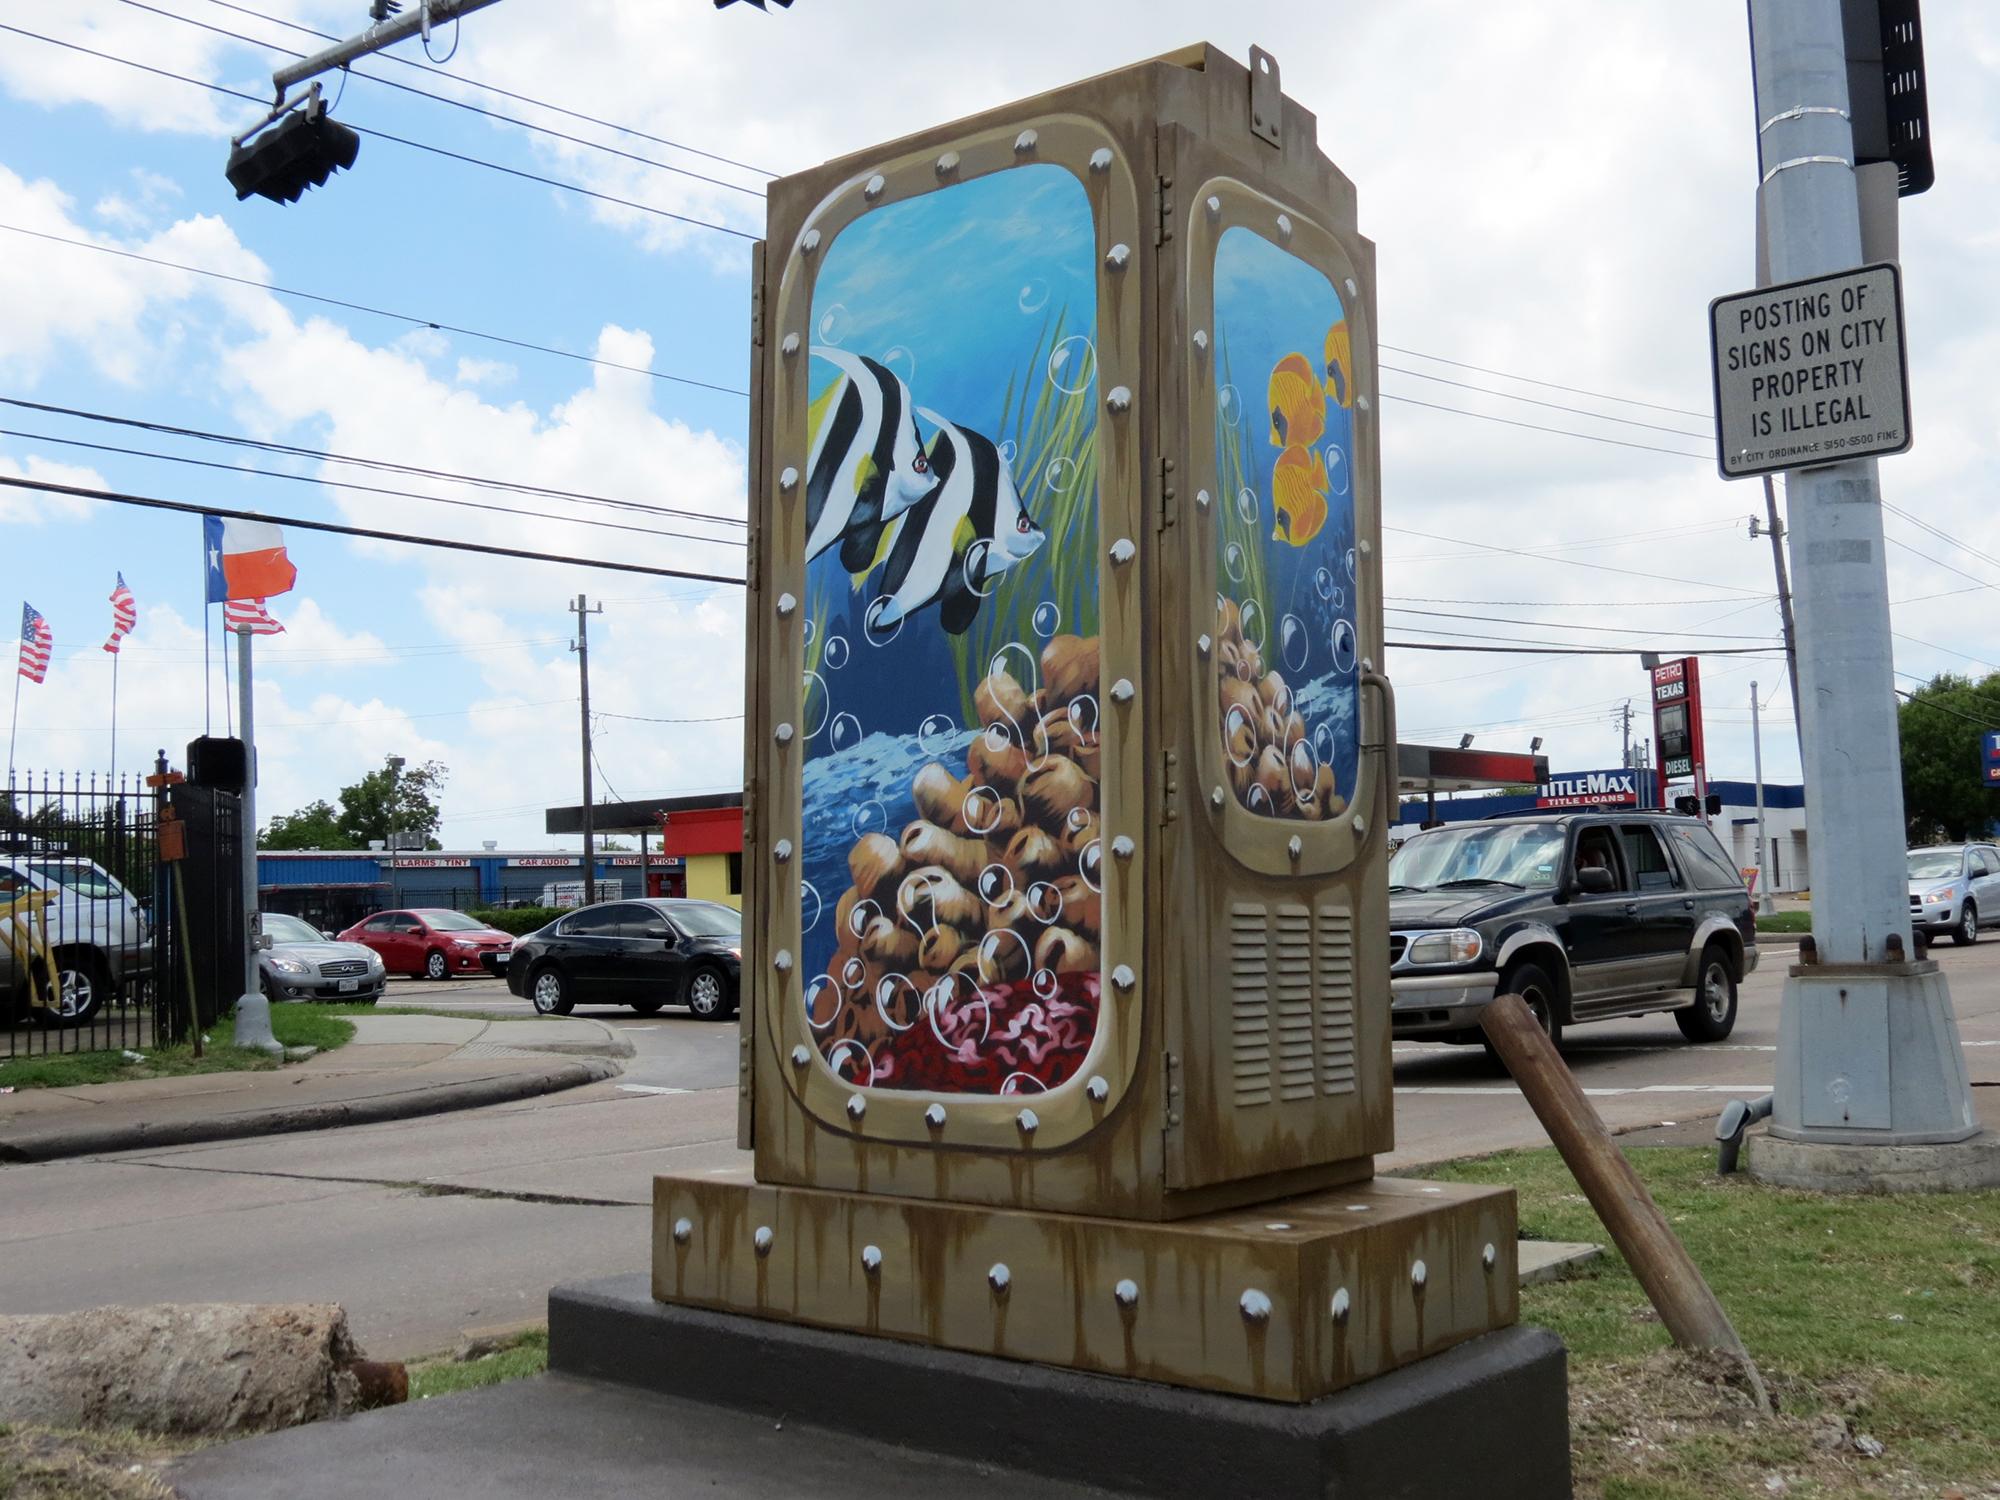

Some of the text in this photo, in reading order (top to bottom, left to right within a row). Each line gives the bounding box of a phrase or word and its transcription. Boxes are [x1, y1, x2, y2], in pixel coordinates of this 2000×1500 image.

[1740, 284, 1868, 334] POSTING OF
[1728, 317, 1886, 371] SIGNS ON CITY
[1752, 358, 1864, 402] PROPERTY
[1752, 394, 1871, 437] IS ILLEGAL
[1730, 455, 1743, 465] BY
[1746, 452, 1764, 463] CITY
[1768, 442, 1819, 459] ORDINANCE
[1877, 429, 1898, 442] FINE
[1655, 663, 1683, 682] PETRO
[1656, 681, 1684, 700] TEXAS
[1665, 761, 1691, 775] DIESEL
[1547, 794, 1625, 806] TITLE LOANS
[394, 859, 436, 867] ALARMS
[445, 858, 468, 866] TINT
[541, 858, 570, 866] AUDIO
[615, 858, 676, 866] INSTAATION
